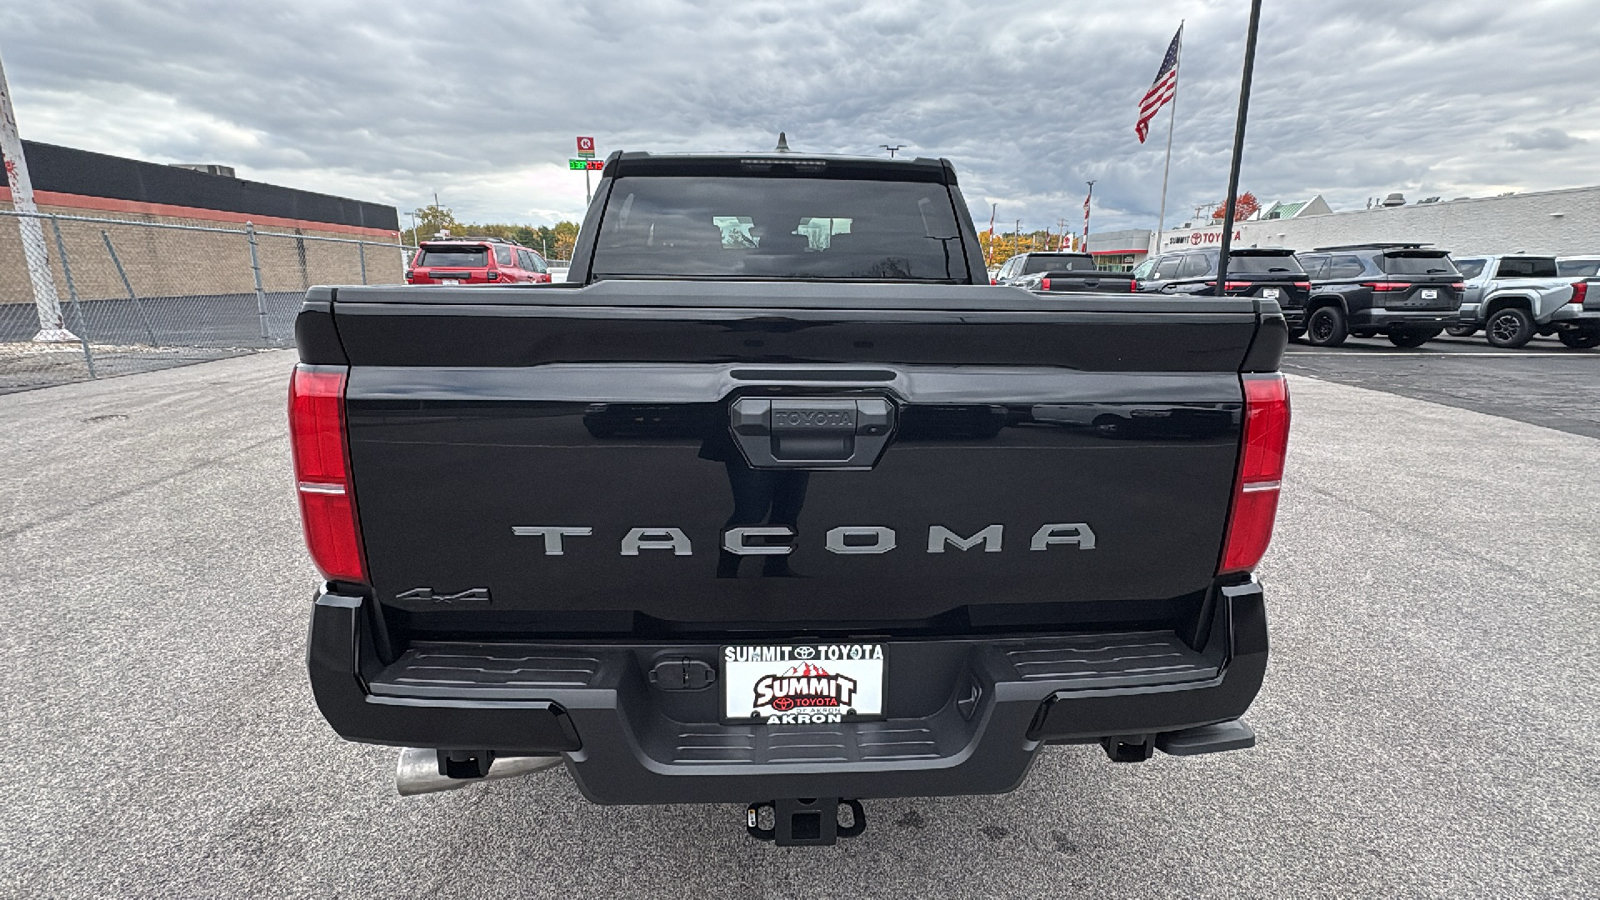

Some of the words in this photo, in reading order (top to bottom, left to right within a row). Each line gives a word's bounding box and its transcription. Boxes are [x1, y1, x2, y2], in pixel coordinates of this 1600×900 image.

[1169, 235, 1190, 245] SUMMIT
[1203, 231, 1241, 243] TOYA
[775, 411, 852, 425] TOYOTA
[511, 523, 1096, 556] TACOMA
[725, 646, 792, 662] SUMMIT
[818, 645, 883, 661] TOYOTA
[756, 676, 854, 705] SUMMIT
[795, 698, 838, 707] TOYOTA
[766, 714, 841, 724] AKRON
